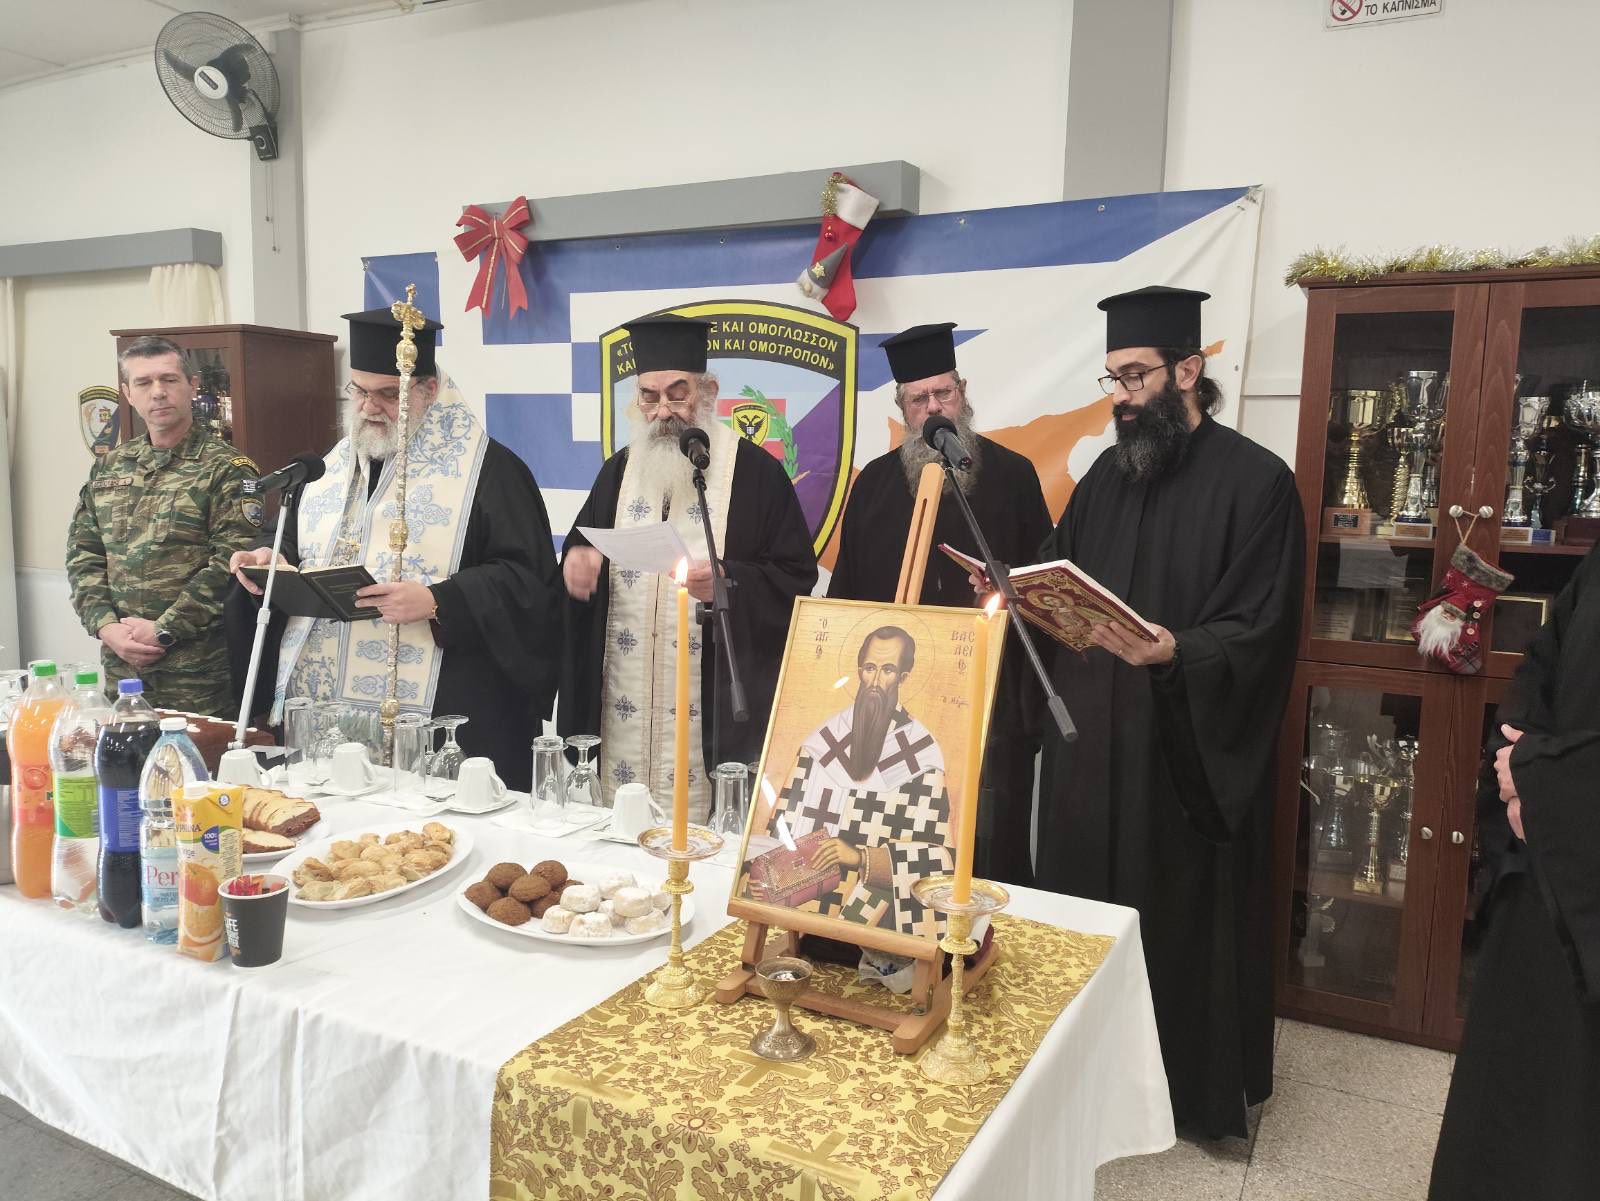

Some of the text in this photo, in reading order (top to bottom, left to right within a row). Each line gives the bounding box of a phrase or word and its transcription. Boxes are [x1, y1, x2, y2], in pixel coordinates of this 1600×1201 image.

[1364, 0, 1437, 16] ΤΟ ΚΑΠΝΙΣΜΑ
[722, 321, 744, 333] ΚΑΙ
[748, 321, 838, 353] ΟΜΟΓΛΩΣΣΟΝ
[616, 358, 637, 375] ΚΑΙ
[724, 339, 745, 351] ΚΑΙ
[749, 339, 835, 371] ΟΜΟΤΡΟΠΟΝ»
[146, 864, 178, 887] Per
